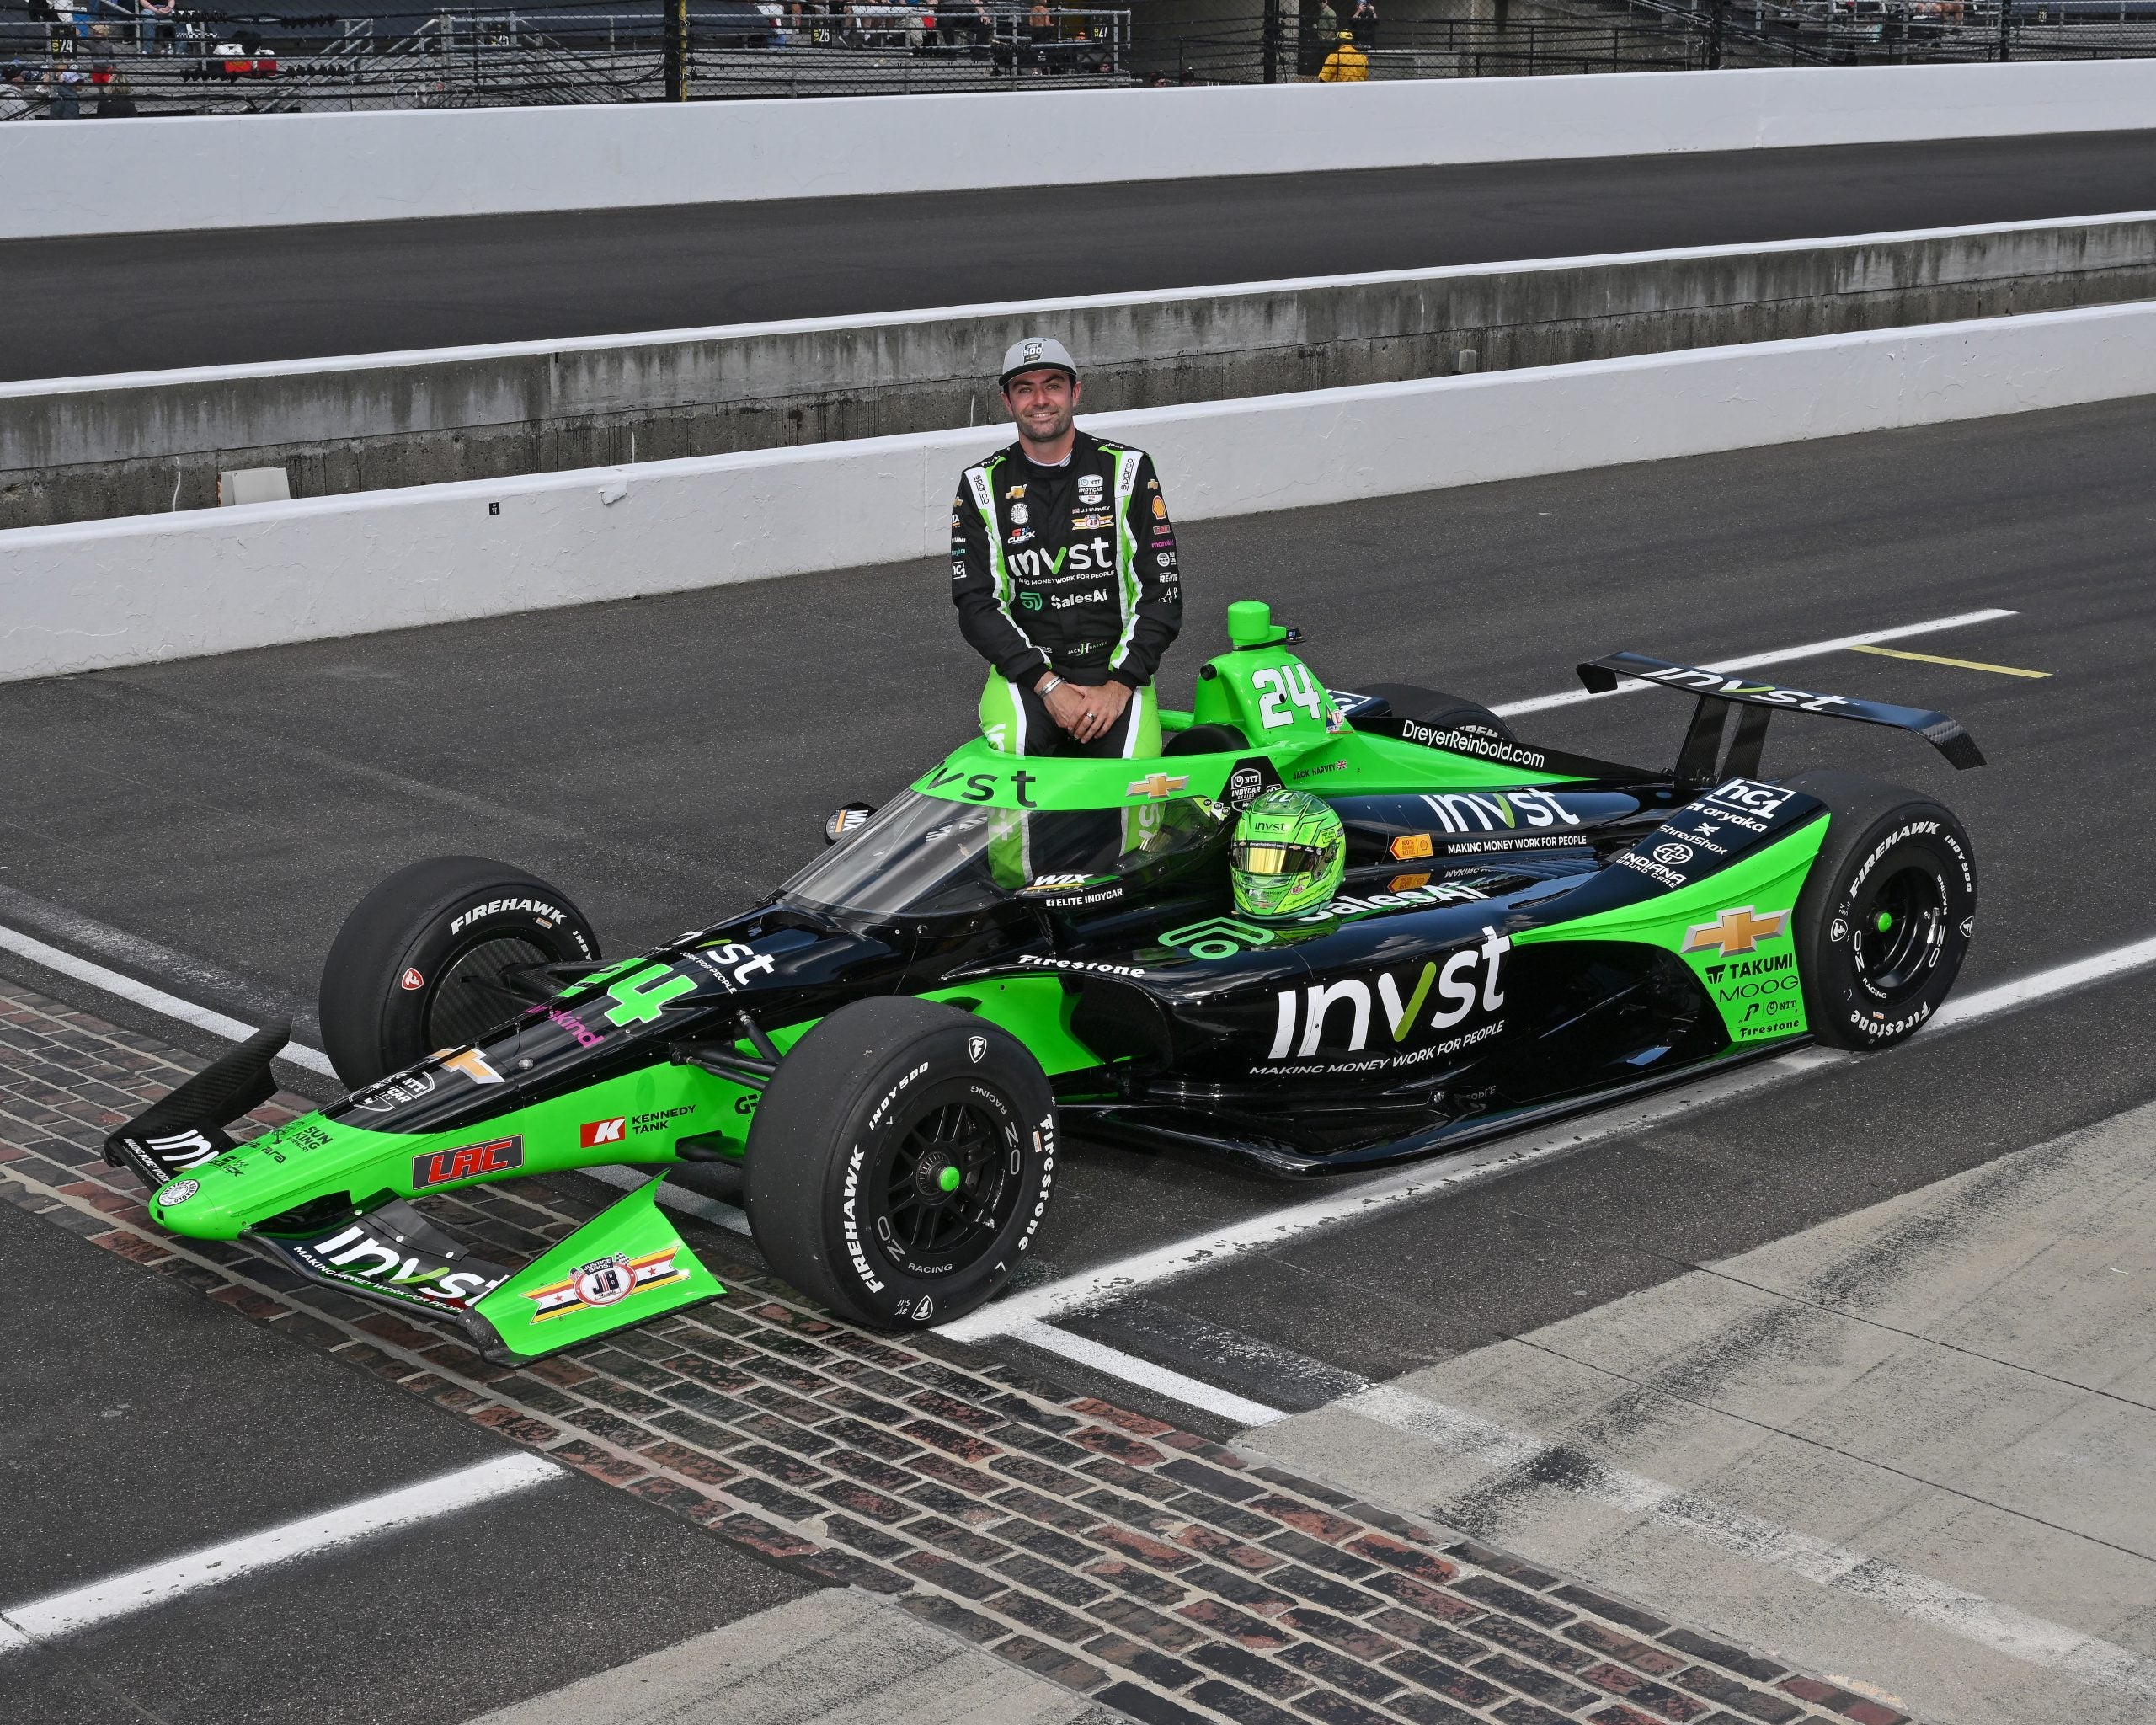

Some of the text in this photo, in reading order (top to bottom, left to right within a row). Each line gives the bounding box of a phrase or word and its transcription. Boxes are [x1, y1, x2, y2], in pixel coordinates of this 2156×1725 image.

[1024, 347, 1042, 356] 500
[1055, 575, 1075, 585] WORK
[1091, 569, 1115, 579] PEOPLE
[1251, 662, 1321, 729] 24
[1401, 719, 1545, 768] DreyerReinbold.com
[1245, 775, 1259, 783] NTT
[1293, 763, 1336, 780] JACK HARVEY
[1231, 786, 1262, 798] INDYCAR
[1703, 804, 1768, 833] aryaka
[1448, 835, 1587, 854] MAKING MONEY WORK FOR PEOPLE
[1657, 824, 1729, 855] ShredShox
[1621, 852, 1687, 884] INDIANA
[1849, 820, 1972, 900] FIREHAWK INDY 500
[1033, 873, 1094, 886] WIX
[1616, 858, 1678, 889] WOUND CARE
[1056, 888, 1123, 906] ELITE INDYCAR
[450, 898, 592, 961] FIREHAWK INDY
[696, 959, 712, 970] FOR
[709, 967, 738, 995] PEOPLE
[1017, 954, 1145, 978] Firestone
[1729, 953, 1793, 980] TAKUMI
[1719, 975, 1799, 1003] MOOG
[1862, 976, 1888, 1000] RACING
[1780, 999, 1796, 1011] NTT
[1739, 1019, 1800, 1039] Firestone
[1850, 1001, 1931, 1039] Firestone
[1249, 1020, 1505, 1075] MAKING MONEY WORK FOR PEOPLE
[402, 1077, 428, 1092] NTT
[868, 1061, 929, 1130] INDY 500
[970, 1085, 1008, 1116] RACING
[632, 1104, 696, 1125] KENNEDY
[632, 1119, 669, 1135] TANK
[293, 1131, 323, 1151] KING
[304, 1125, 334, 1146] SUN
[593, 1118, 626, 1144] K
[428, 1140, 512, 1183] LAC
[1017, 1114, 1055, 1252] Firestone
[843, 1144, 884, 1294] FIREHAWK
[294, 1246, 337, 1276] MAKING
[335, 1271, 374, 1286] MONEY
[371, 1281, 410, 1297] WORK
[407, 1292, 430, 1304] FOR
[584, 1258, 611, 1271] JUSTICE
[908, 1262, 953, 1274] RACING
[592, 1269, 619, 1294] JB
